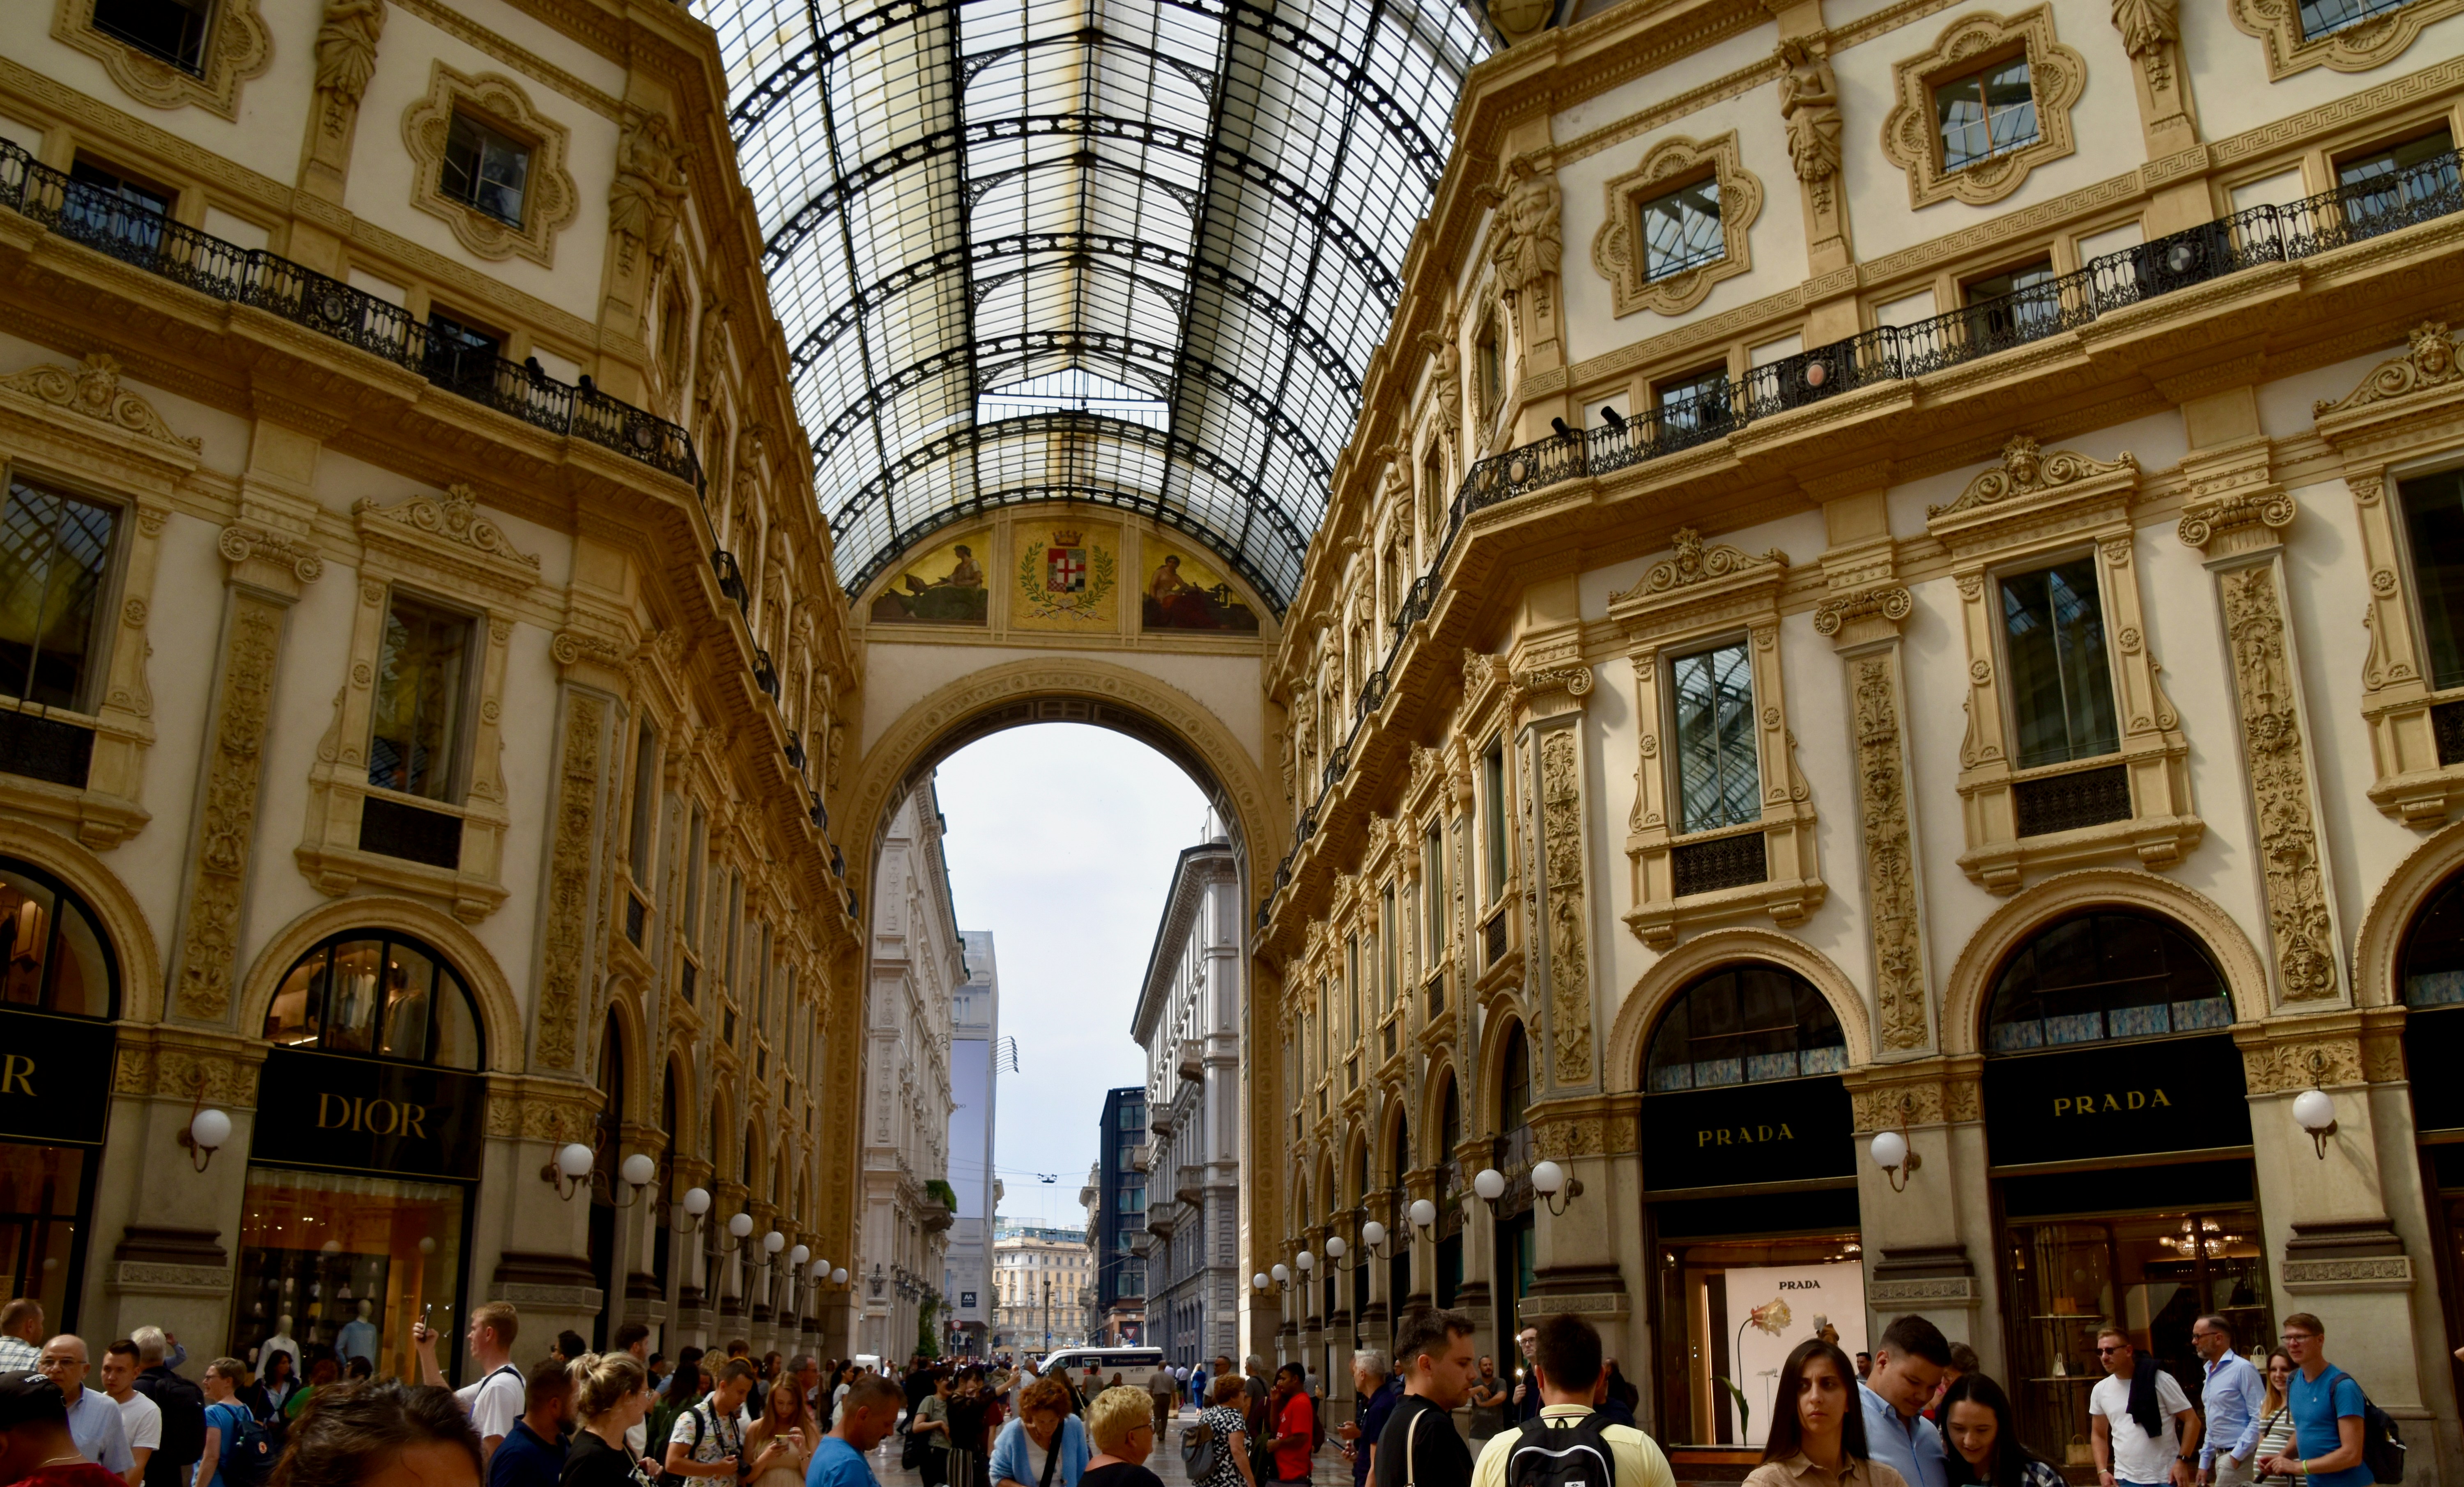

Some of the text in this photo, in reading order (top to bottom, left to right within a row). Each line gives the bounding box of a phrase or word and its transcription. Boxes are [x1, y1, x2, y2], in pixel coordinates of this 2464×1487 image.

[2054, 1088, 2172, 1116] PRADA
[316, 1093, 426, 1139] DIOR
[1699, 1123, 1794, 1147] PRADA
[1779, 1280, 1820, 1290] PRADA
